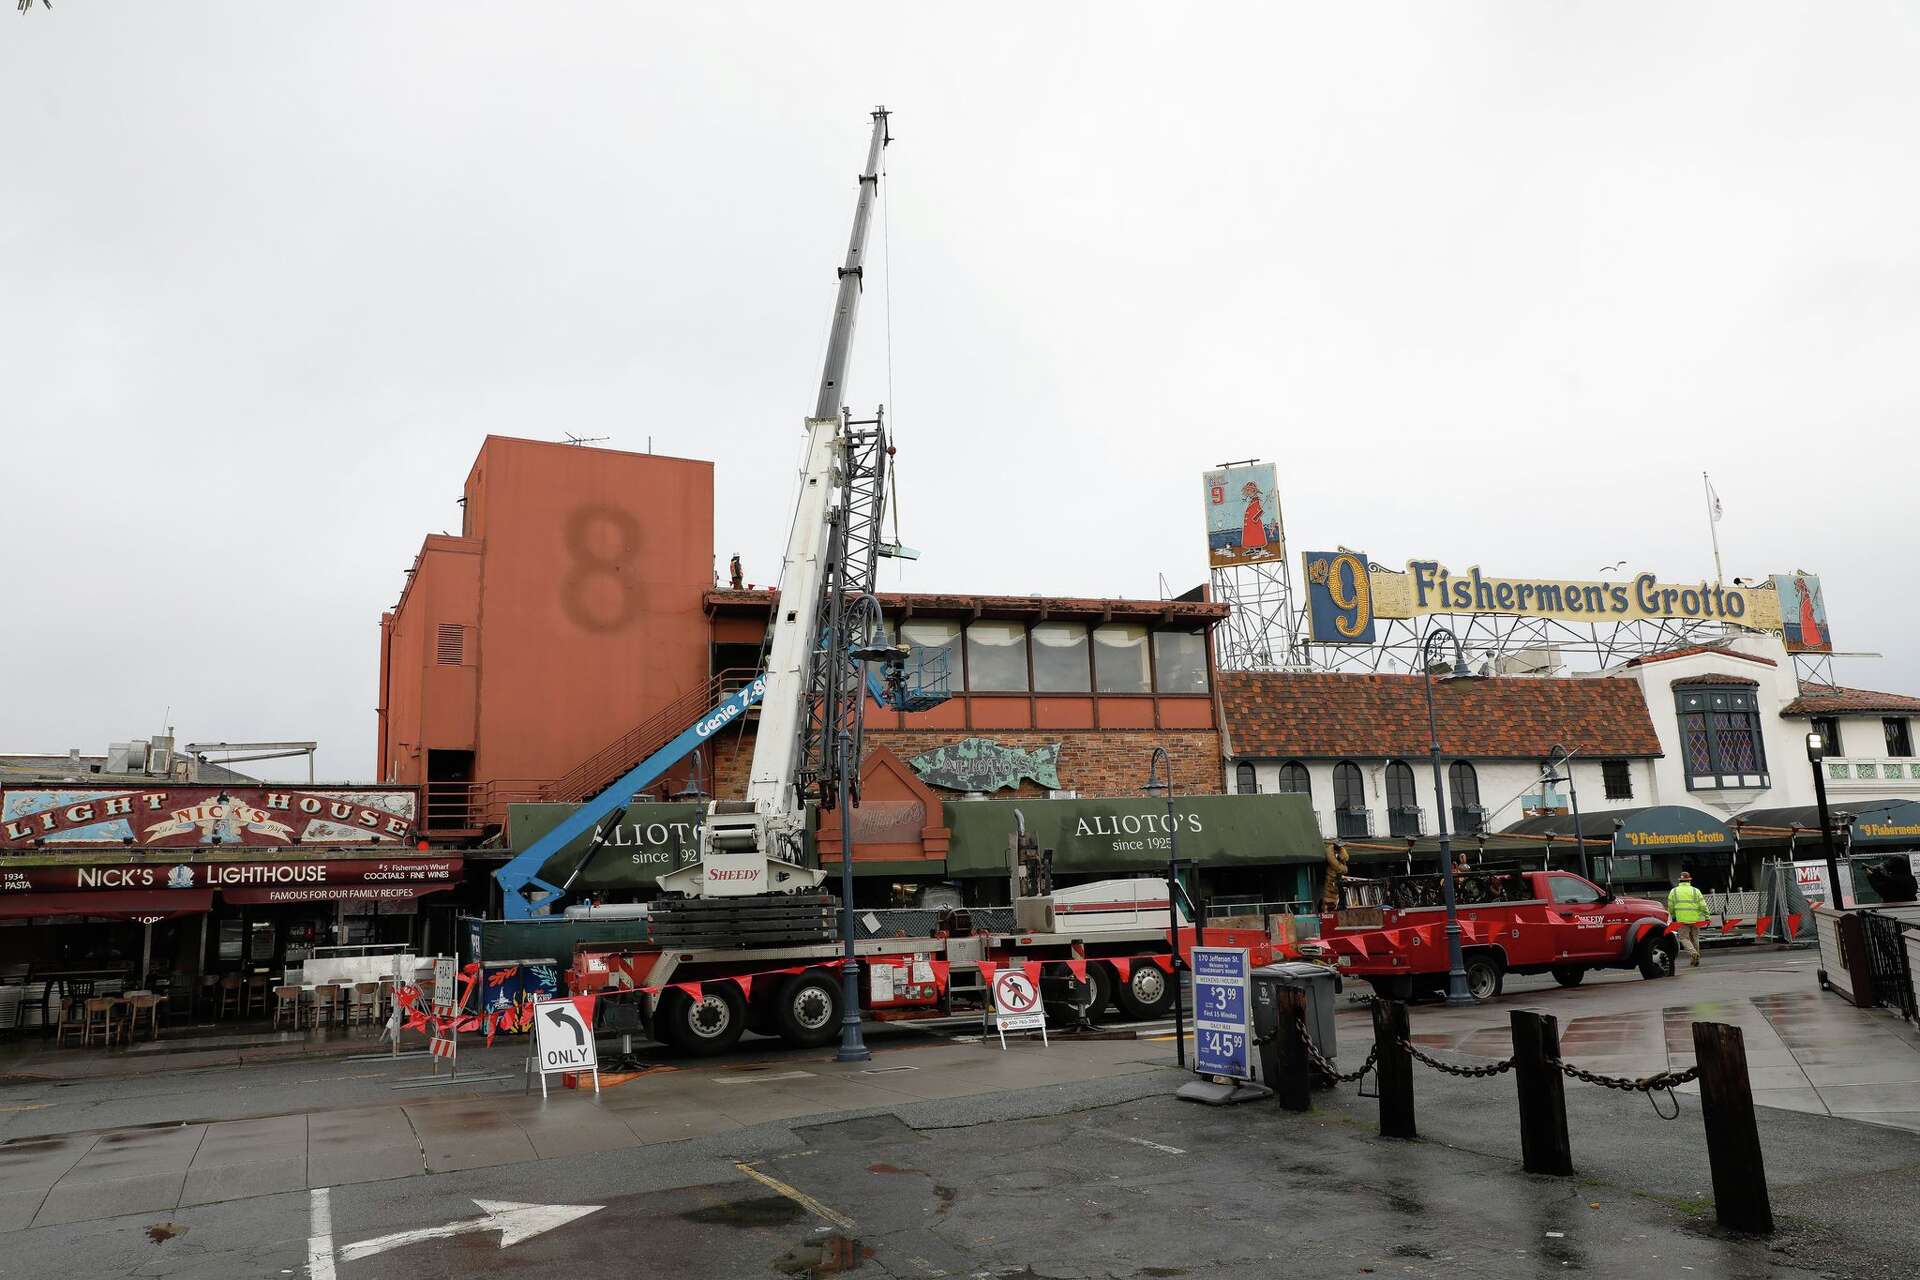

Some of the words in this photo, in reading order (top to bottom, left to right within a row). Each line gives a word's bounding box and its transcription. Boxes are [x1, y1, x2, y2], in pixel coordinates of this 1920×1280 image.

[560, 503, 647, 633] 8
[1328, 553, 1370, 638] 9
[1409, 560, 1629, 614] Fishermen's
[1634, 572, 1746, 618] Grotto
[695, 704, 739, 737] Genie
[4, 792, 169, 841] LIGHT
[266, 792, 411, 838] HOUSE
[1074, 813, 1203, 837] ALIOTO'S
[1112, 839, 1145, 851] since
[1147, 837, 1172, 849] 1925
[1695, 829, 1725, 843] Grotto
[632, 850, 670, 864] since
[4, 873, 24, 881] 1934
[77, 867, 155, 888] NICK'S
[206, 865, 327, 884] LIGHTHOUSE
[363, 872, 405, 881] COCKTAILS
[410, 871, 425, 880] FINE
[427, 870, 449, 879] WINES
[707, 868, 761, 881] SHEEDY
[5, 881, 32, 890] PASTA
[270, 890, 308, 900] FAMOUS
[310, 890, 327, 899] FOR
[329, 889, 348, 899] OUR
[349, 889, 380, 898] FAMILY
[380, 888, 414, 898] RECIPES
[547, 1048, 588, 1066] ONLY
